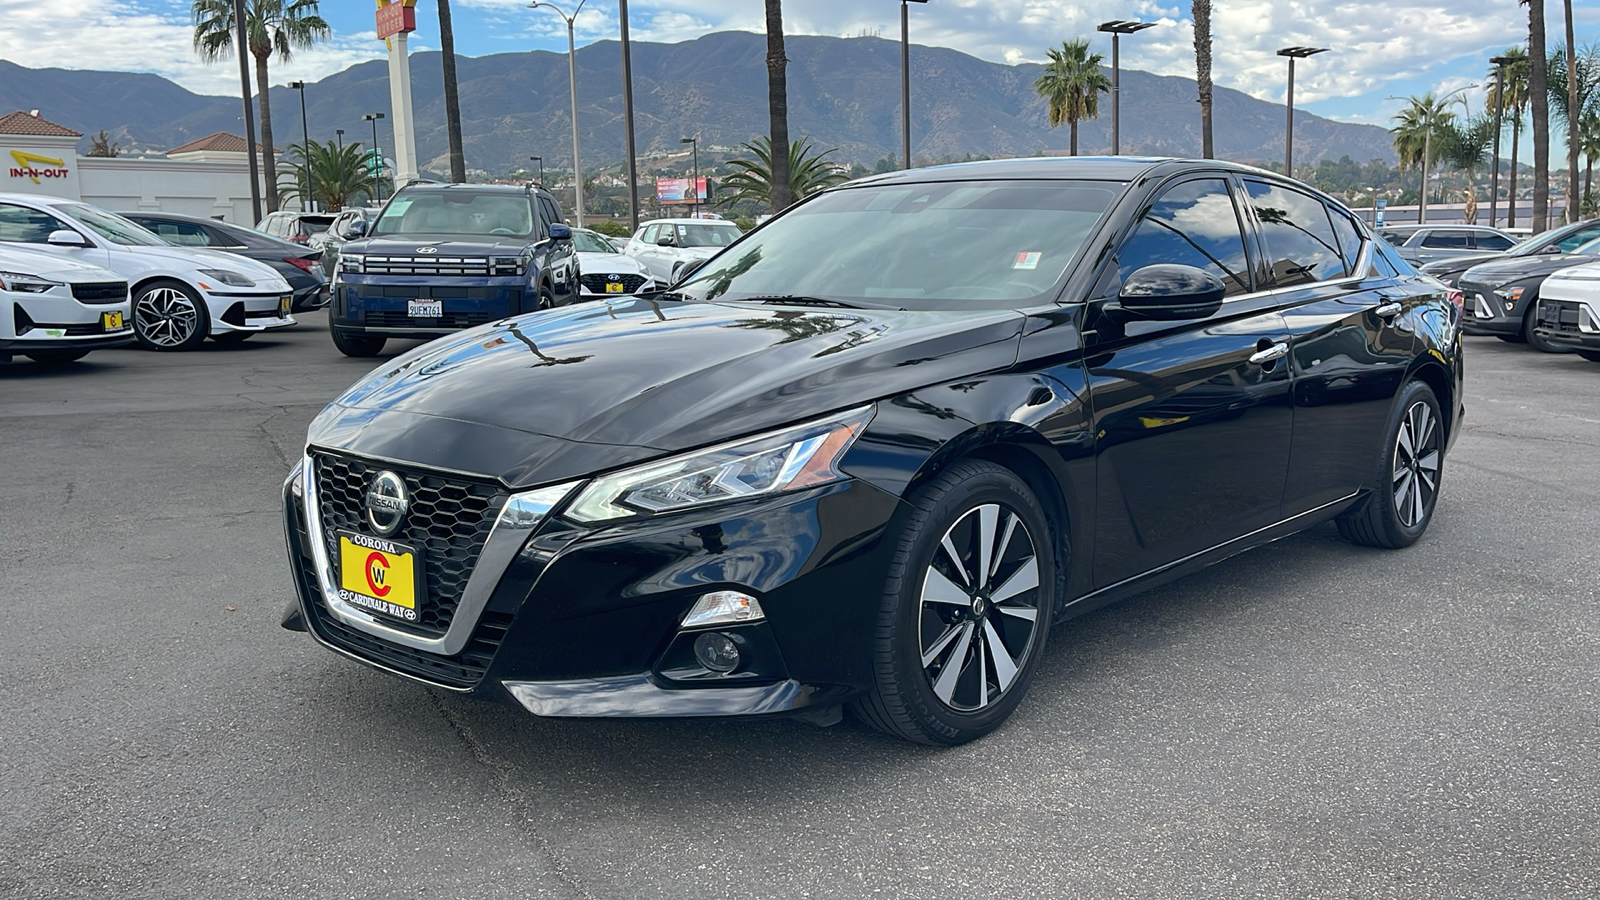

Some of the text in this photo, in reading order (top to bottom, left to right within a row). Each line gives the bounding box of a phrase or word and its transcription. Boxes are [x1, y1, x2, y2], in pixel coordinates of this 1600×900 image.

[377, 3, 402, 23] IN-N-OUT
[378, 16, 402, 36] BURGER
[10, 168, 68, 178] IN-N-OUT
[410, 305, 440, 315] 9UFM761
[370, 496, 400, 510] NISSAN
[354, 534, 396, 554] CORONA
[349, 592, 405, 618] CARDINALE WAY
